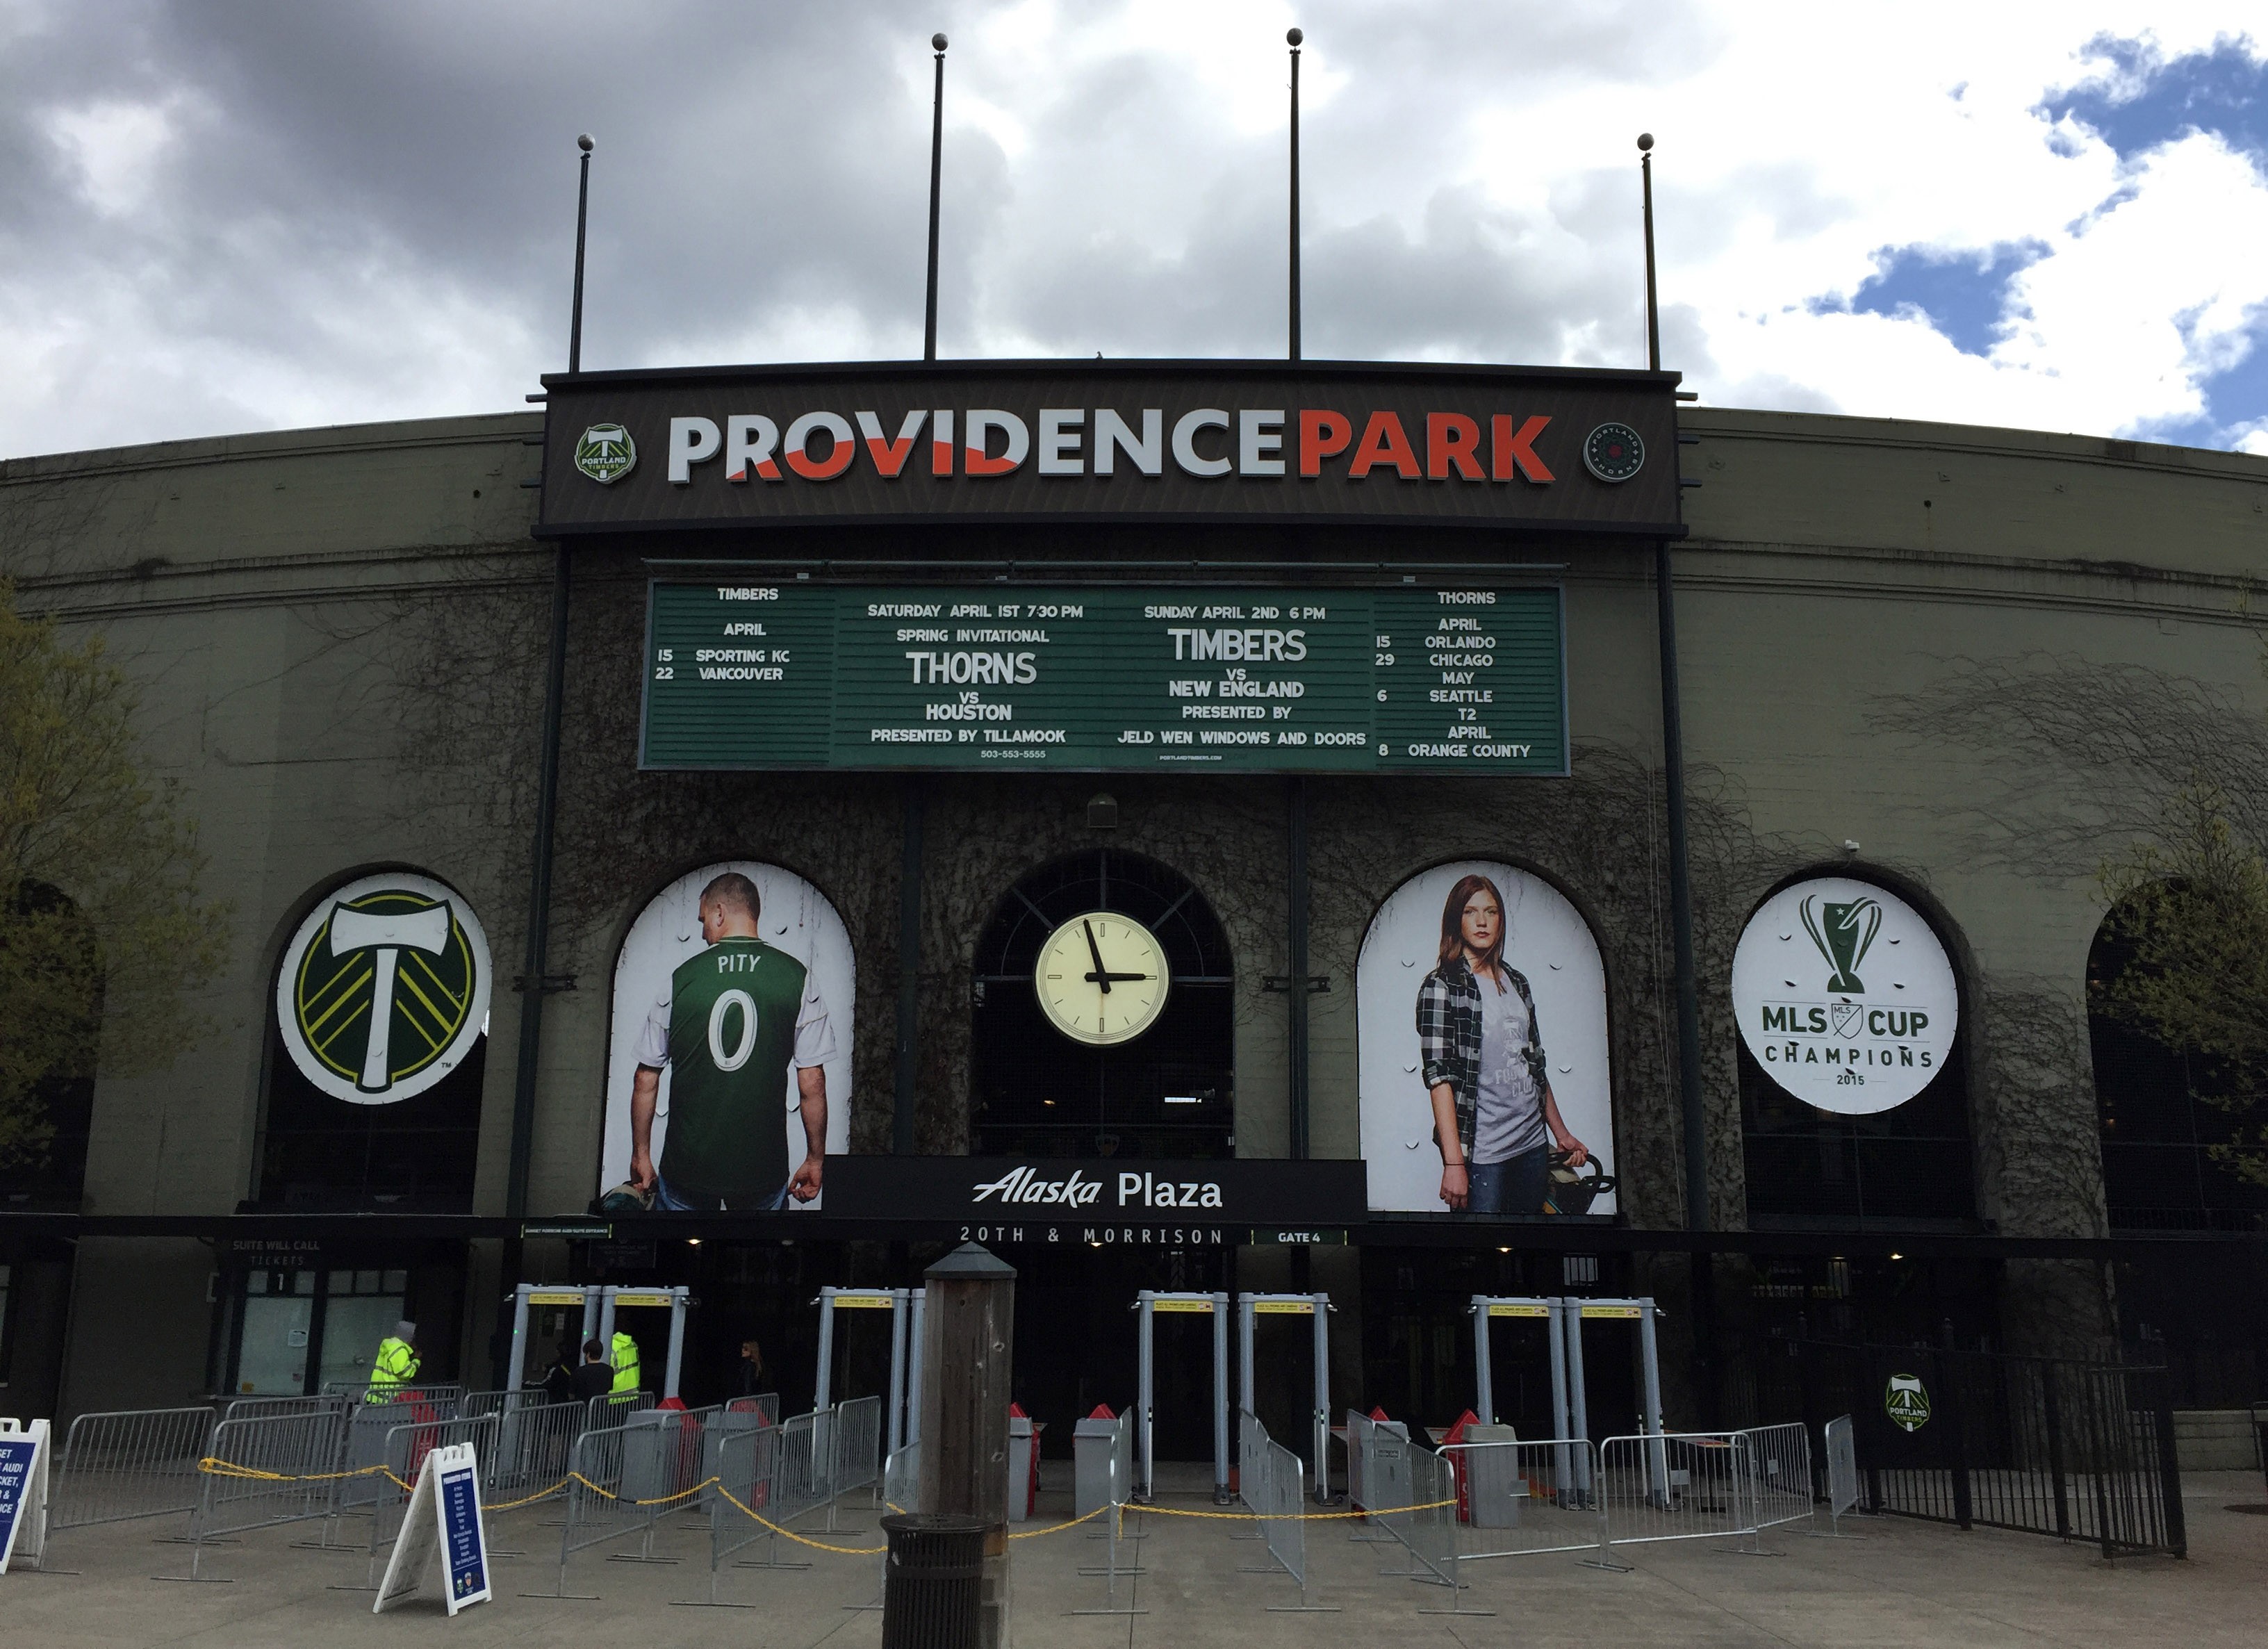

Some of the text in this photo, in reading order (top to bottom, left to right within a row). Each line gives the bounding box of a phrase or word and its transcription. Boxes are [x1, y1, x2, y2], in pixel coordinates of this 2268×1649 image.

[1593, 428, 1638, 447] PORTLAND
[582, 457, 626, 465] PORTLAND
[1594, 457, 1638, 475] THORNS
[718, 588, 778, 600] TIMBERS
[1438, 592, 1495, 604] THORNS
[868, 605, 942, 616] SATURDAY
[950, 605, 992, 617] APRIL
[1062, 605, 1083, 617] PM
[1145, 606, 1325, 619] SUNDAY APRIL 2ND 6 PM
[724, 623, 766, 635] APRIL
[1438, 618, 1481, 630] APRIL
[897, 630, 1049, 642] SPRING INVITATIONAL
[1377, 636, 1495, 648] 15 ORLANDO
[1167, 629, 1306, 661] TIMBERS
[659, 649, 789, 662] 15 SPORTING KC
[1375, 654, 1493, 666] 29 CHICAGO
[655, 667, 782, 680] 22 VANCOUVER
[906, 652, 1037, 684] THORNS
[1226, 668, 1246, 680] VS
[1443, 672, 1474, 684] MAY
[1169, 680, 1304, 697] NEW ENGLAND
[960, 692, 978, 704] VS
[1377, 689, 1493, 703] 6 SEATTLE
[926, 704, 1012, 720] HOUSTON
[1183, 706, 1292, 719] PRESENTED BY
[1458, 708, 1476, 720] T2
[871, 729, 1065, 742] PRESENTED BY TILLAMOOK
[1117, 731, 1365, 745] JELD WEN WINDOWS AND DOORS
[1448, 726, 1491, 739] APRIL
[1379, 744, 1531, 757] 8 ORANGE COUNTY
[718, 954, 761, 973] PITY
[1762, 1006, 1929, 1037] MLS CUP
[709, 989, 758, 1071] 0
[1766, 1045, 1932, 1067] CHAMPIONS
[1837, 1075, 1864, 1085] 2015
[972, 1166, 1223, 1208] Alaska Plaza
[960, 1227, 1222, 1243] 20TH & MORRISON
[1278, 1233, 1321, 1242] GATE 4
[233, 1240, 320, 1250] SUITE WILL CALL
[251, 1256, 305, 1265] TICKETS
[1890, 1407, 1928, 1417] PORTLAND
[2, 1463, 24, 1472] AUDI
